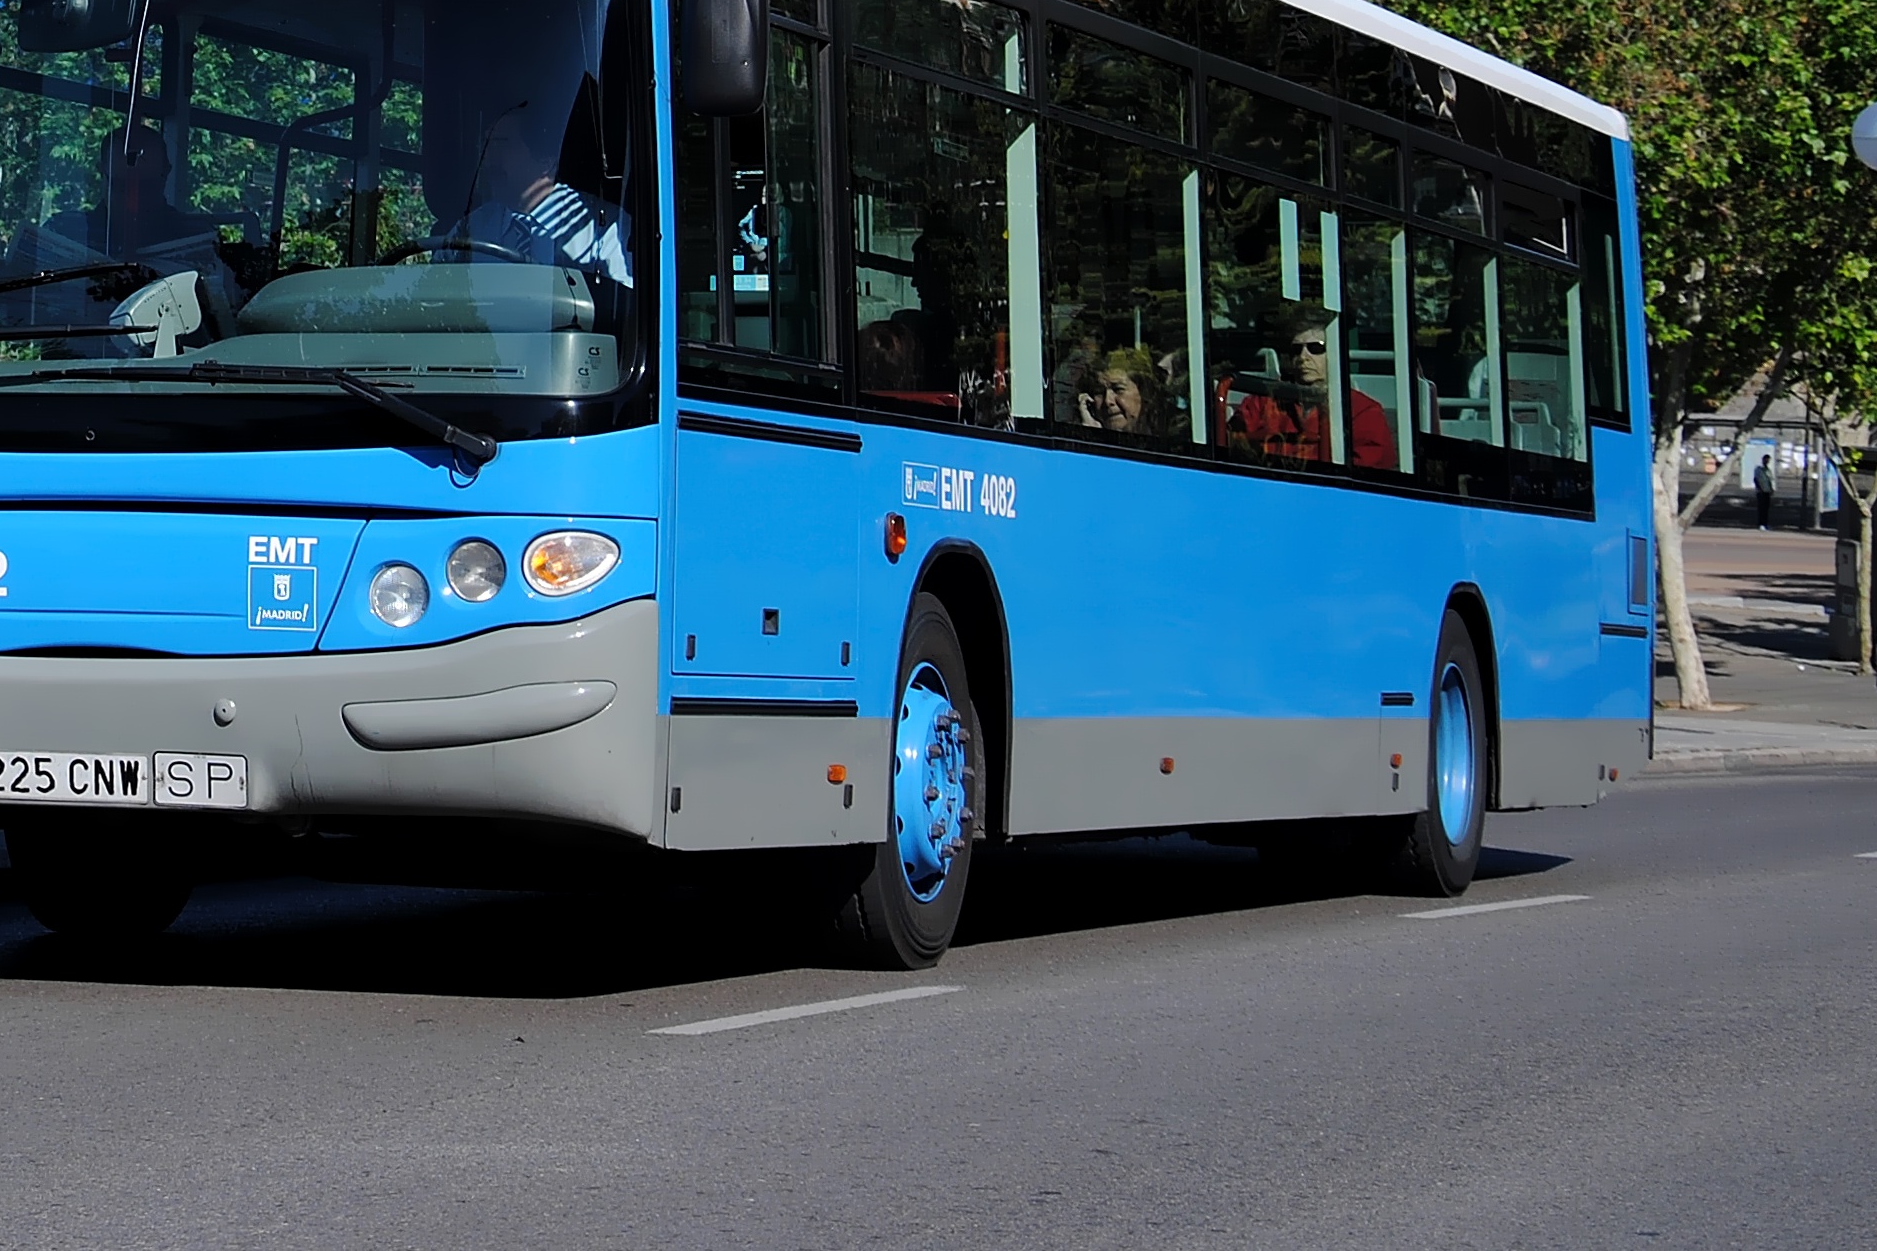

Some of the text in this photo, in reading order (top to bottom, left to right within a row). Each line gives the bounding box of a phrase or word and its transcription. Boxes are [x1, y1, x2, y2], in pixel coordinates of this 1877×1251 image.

[941, 467, 1016, 518] EMT 4082
[248, 535, 319, 564] EMT
[68, 758, 140, 796] CNW
